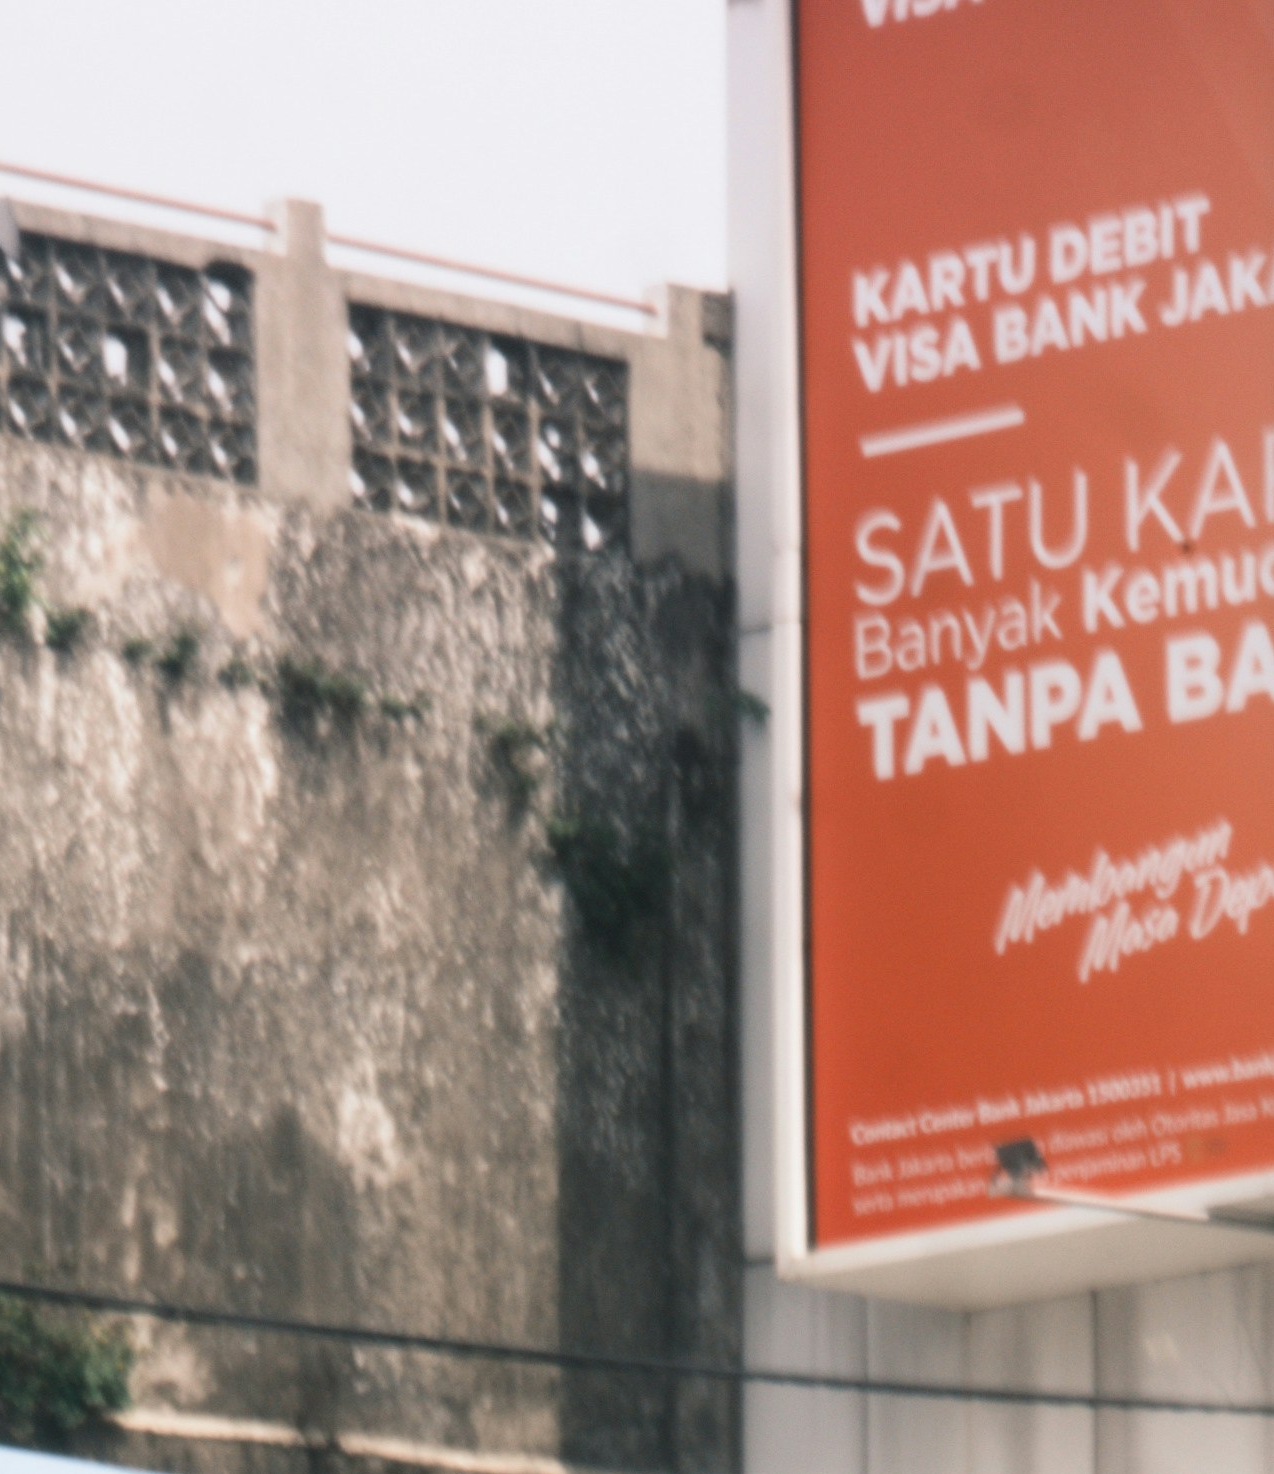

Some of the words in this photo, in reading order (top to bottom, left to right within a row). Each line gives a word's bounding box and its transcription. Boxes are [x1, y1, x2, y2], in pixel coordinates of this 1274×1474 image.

[852, 232, 1036, 330] KARTU
[1048, 194, 1212, 285] DEBIT
[851, 315, 981, 394] VISA
[991, 275, 1148, 366] BANK
[853, 464, 1089, 607] SATU
[853, 578, 1063, 682] Banyak
[855, 647, 1145, 782] TANPA
[994, 819, 1232, 956] Membangun
[1076, 898, 1180, 985] Masa
[977, 1094, 1020, 1126] Bank
